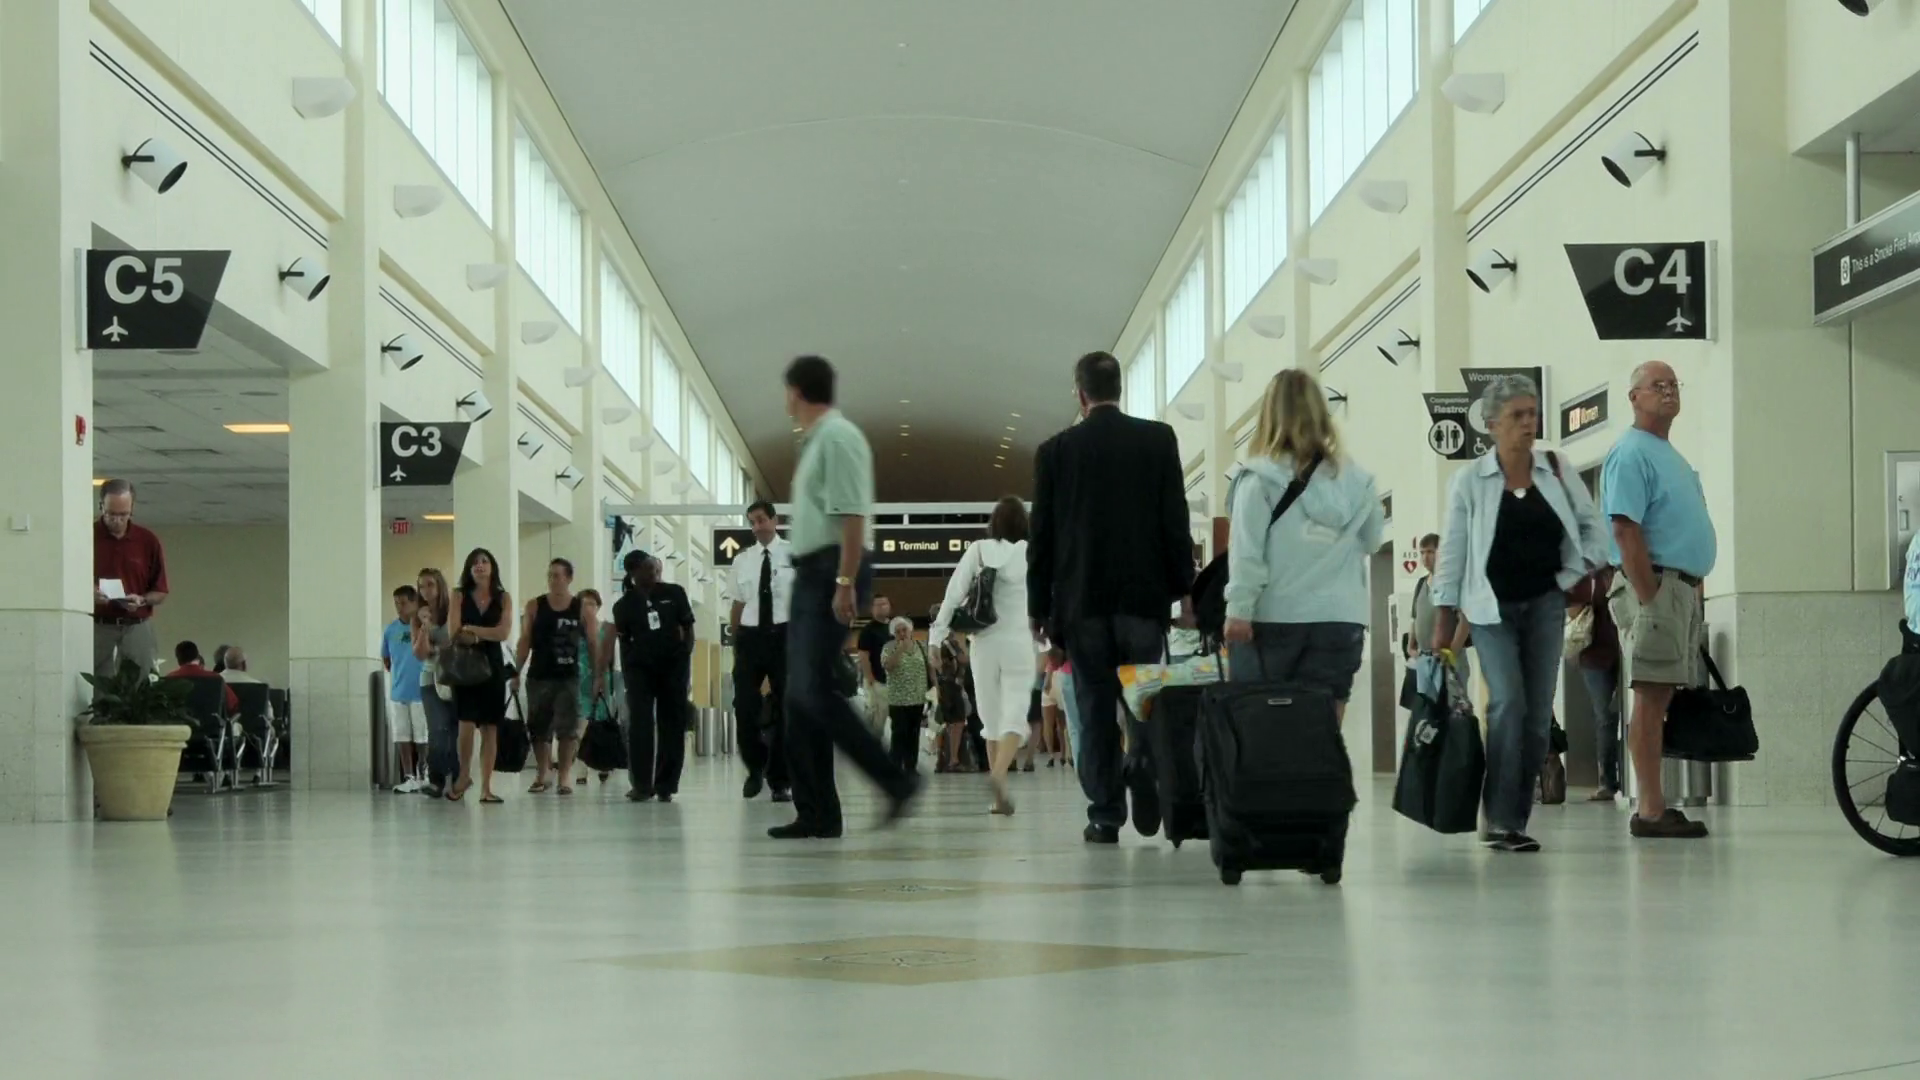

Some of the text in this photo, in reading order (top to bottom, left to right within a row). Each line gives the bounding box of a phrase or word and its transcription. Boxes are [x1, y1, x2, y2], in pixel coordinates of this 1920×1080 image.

[1874, 244, 1893, 263] Smoke
[1893, 237, 1907, 254] Free
[105, 255, 184, 304] C5
[1614, 247, 1692, 296] C4
[391, 425, 442, 457] C3
[898, 540, 939, 551] Terminal
